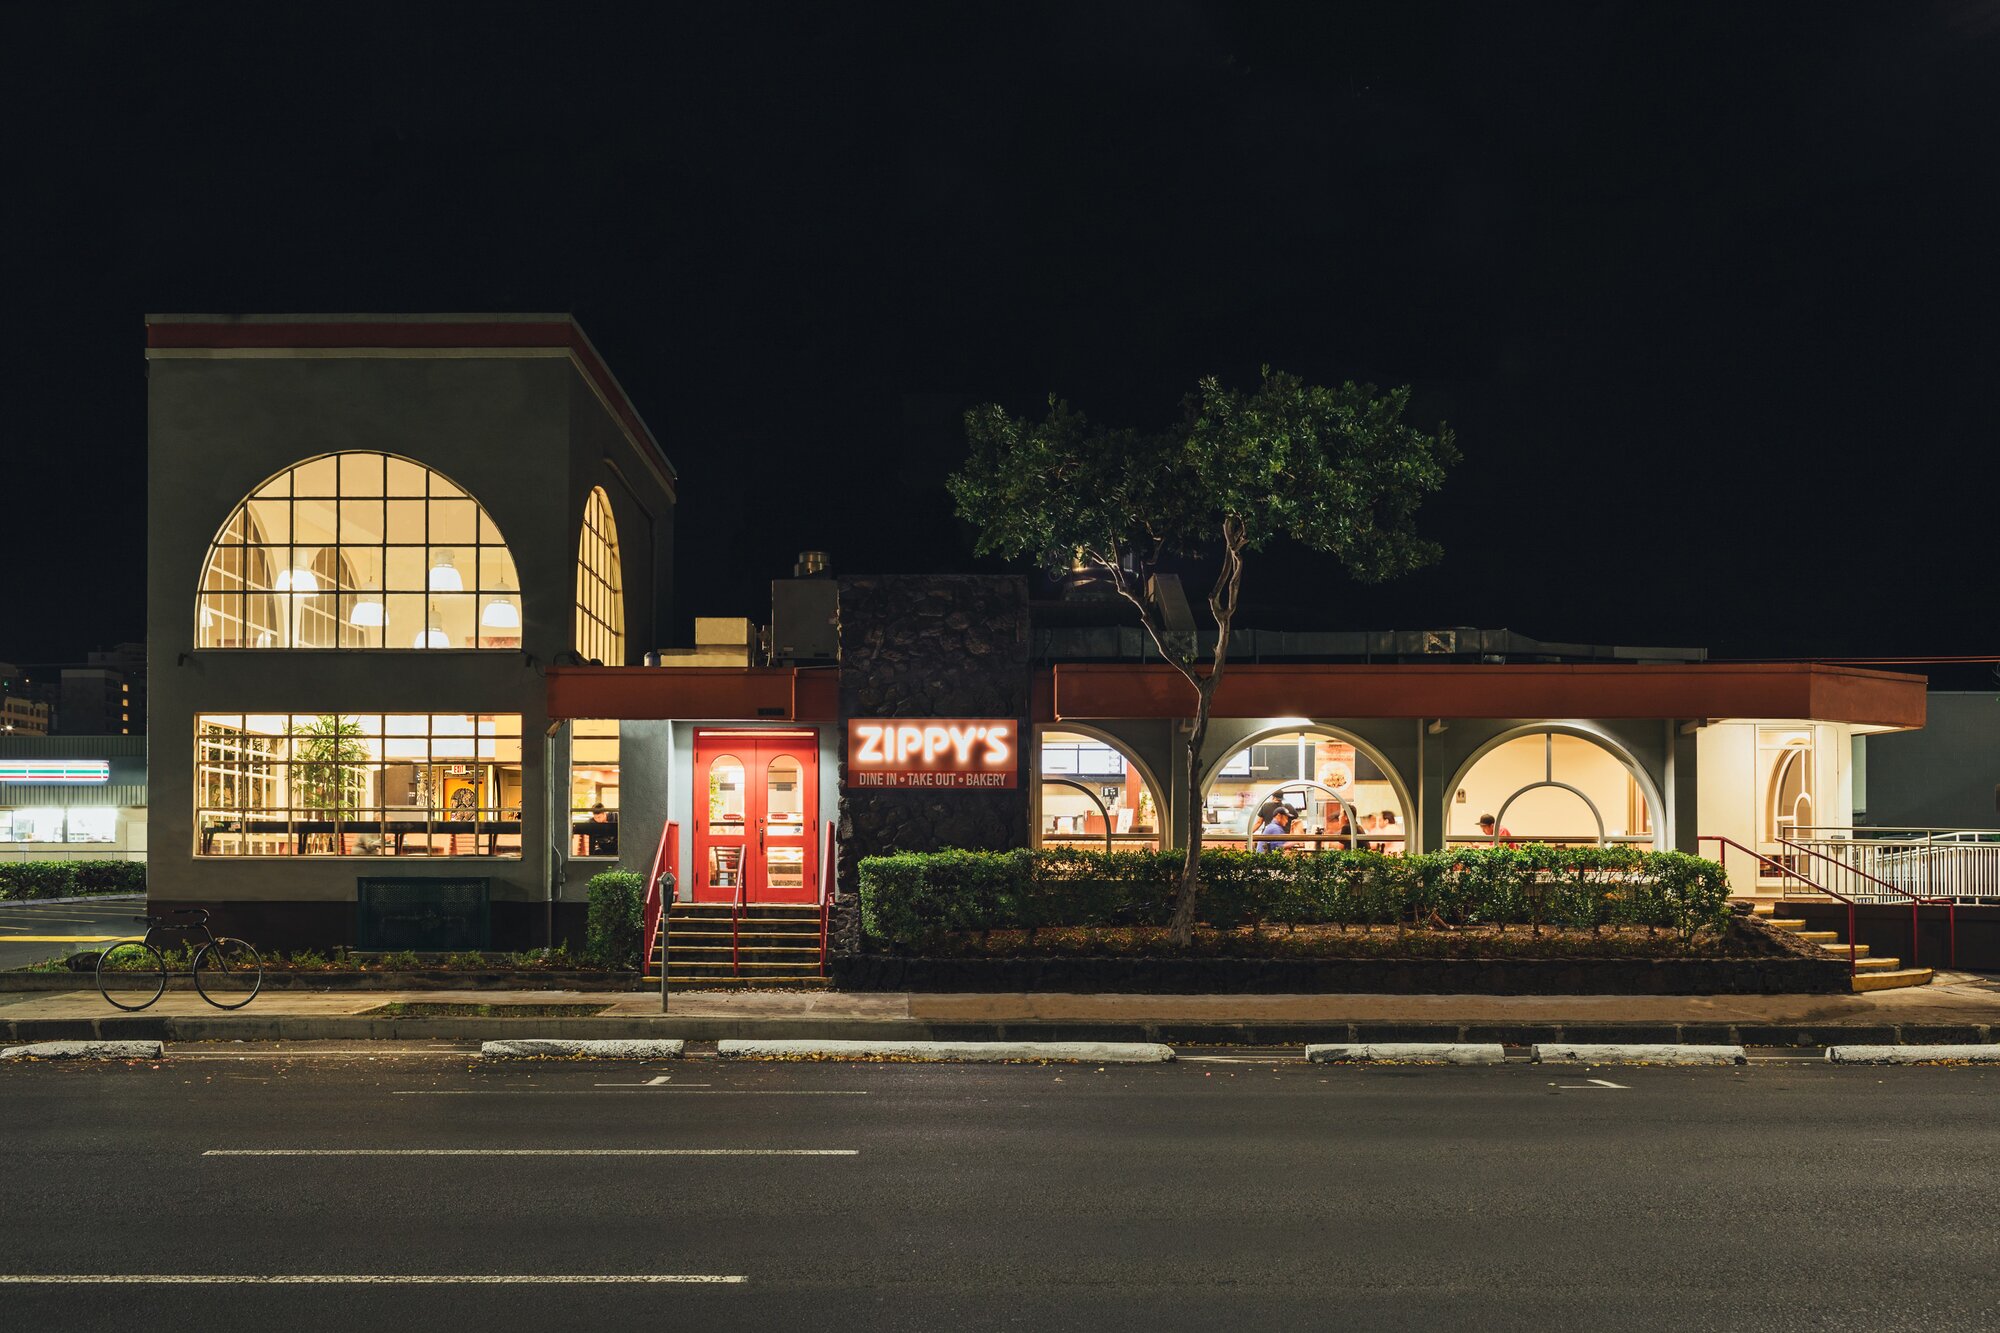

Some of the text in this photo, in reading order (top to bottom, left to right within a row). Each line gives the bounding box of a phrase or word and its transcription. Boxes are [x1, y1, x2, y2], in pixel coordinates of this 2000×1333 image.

[857, 726, 1009, 762] ZIPPY'S
[859, 772, 1006, 787] DINE IN TAKE OUT BAKERY
